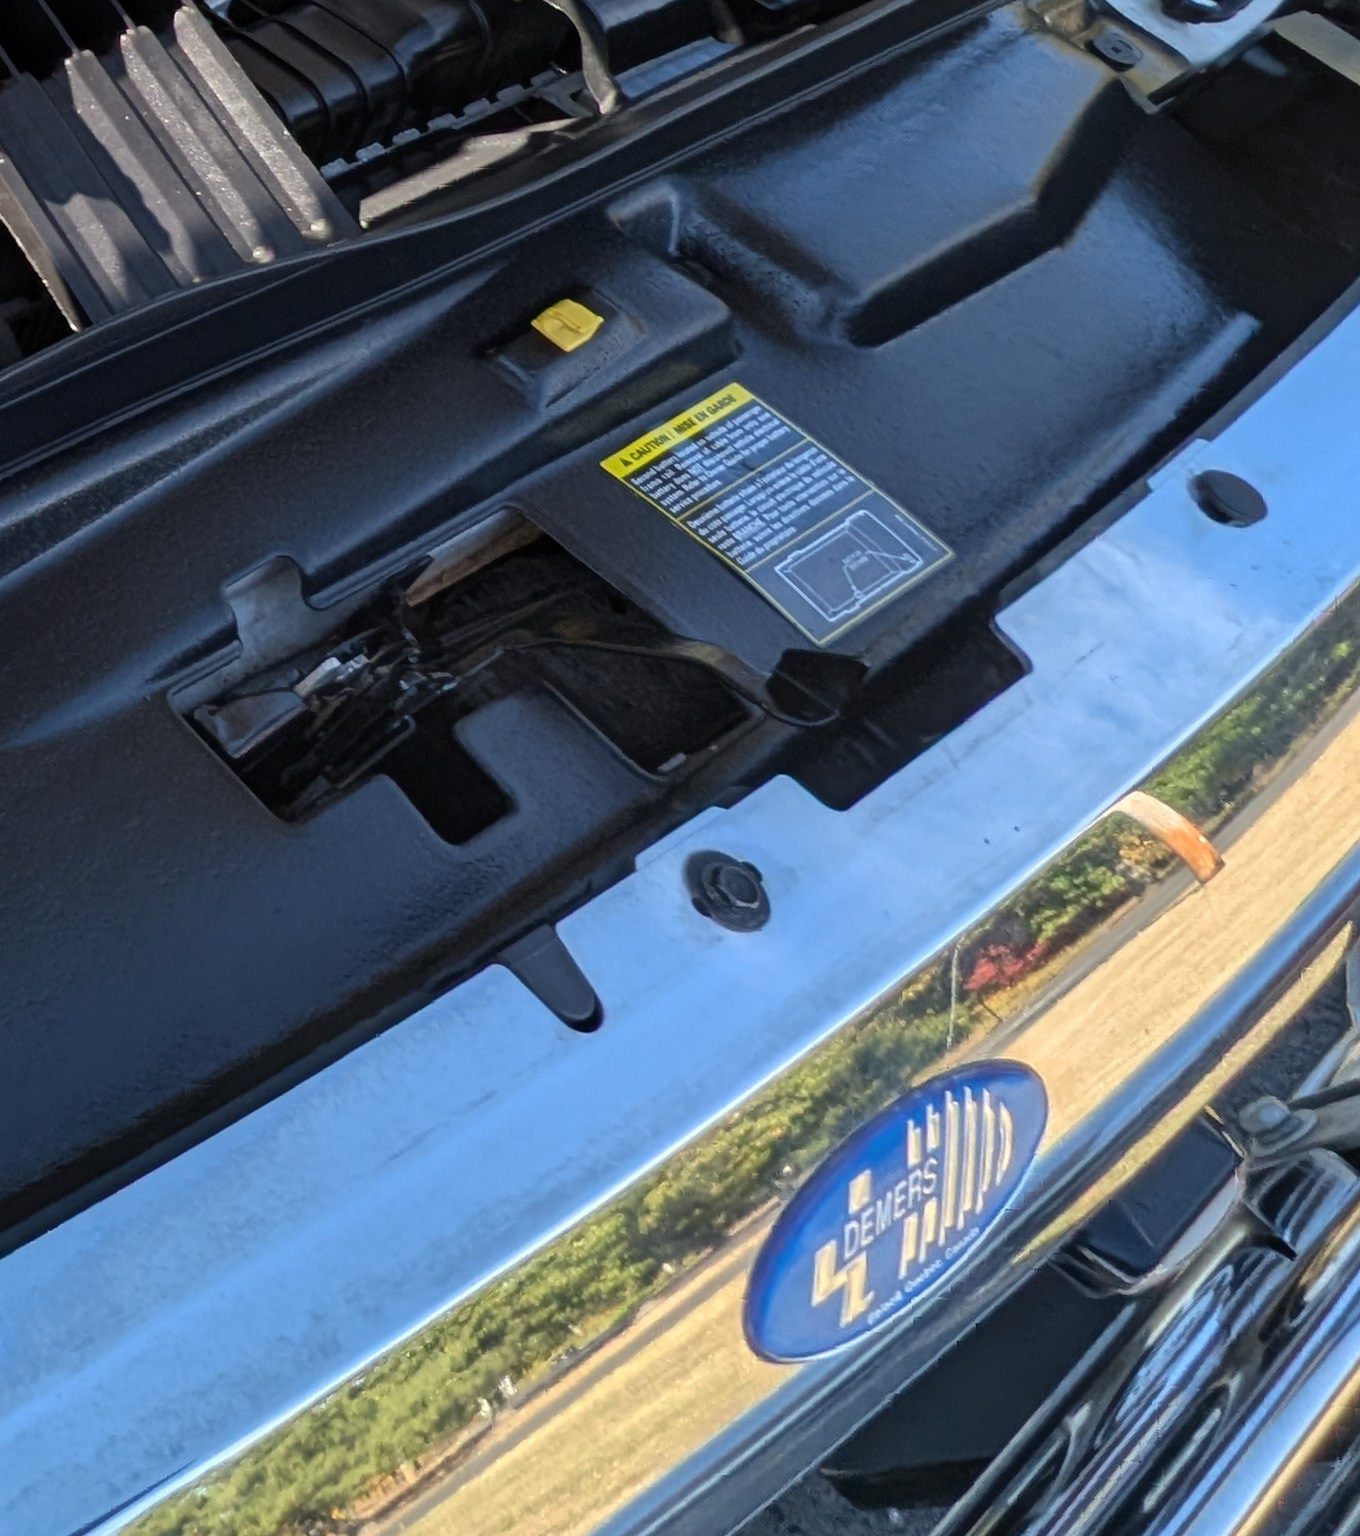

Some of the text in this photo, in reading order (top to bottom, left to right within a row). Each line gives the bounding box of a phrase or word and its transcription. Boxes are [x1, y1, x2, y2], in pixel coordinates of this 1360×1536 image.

[628, 434, 671, 460] CAUTION
[672, 418, 697, 434] MISE
[704, 394, 737, 414] GARDE
[844, 1158, 937, 1260] DEMERS
